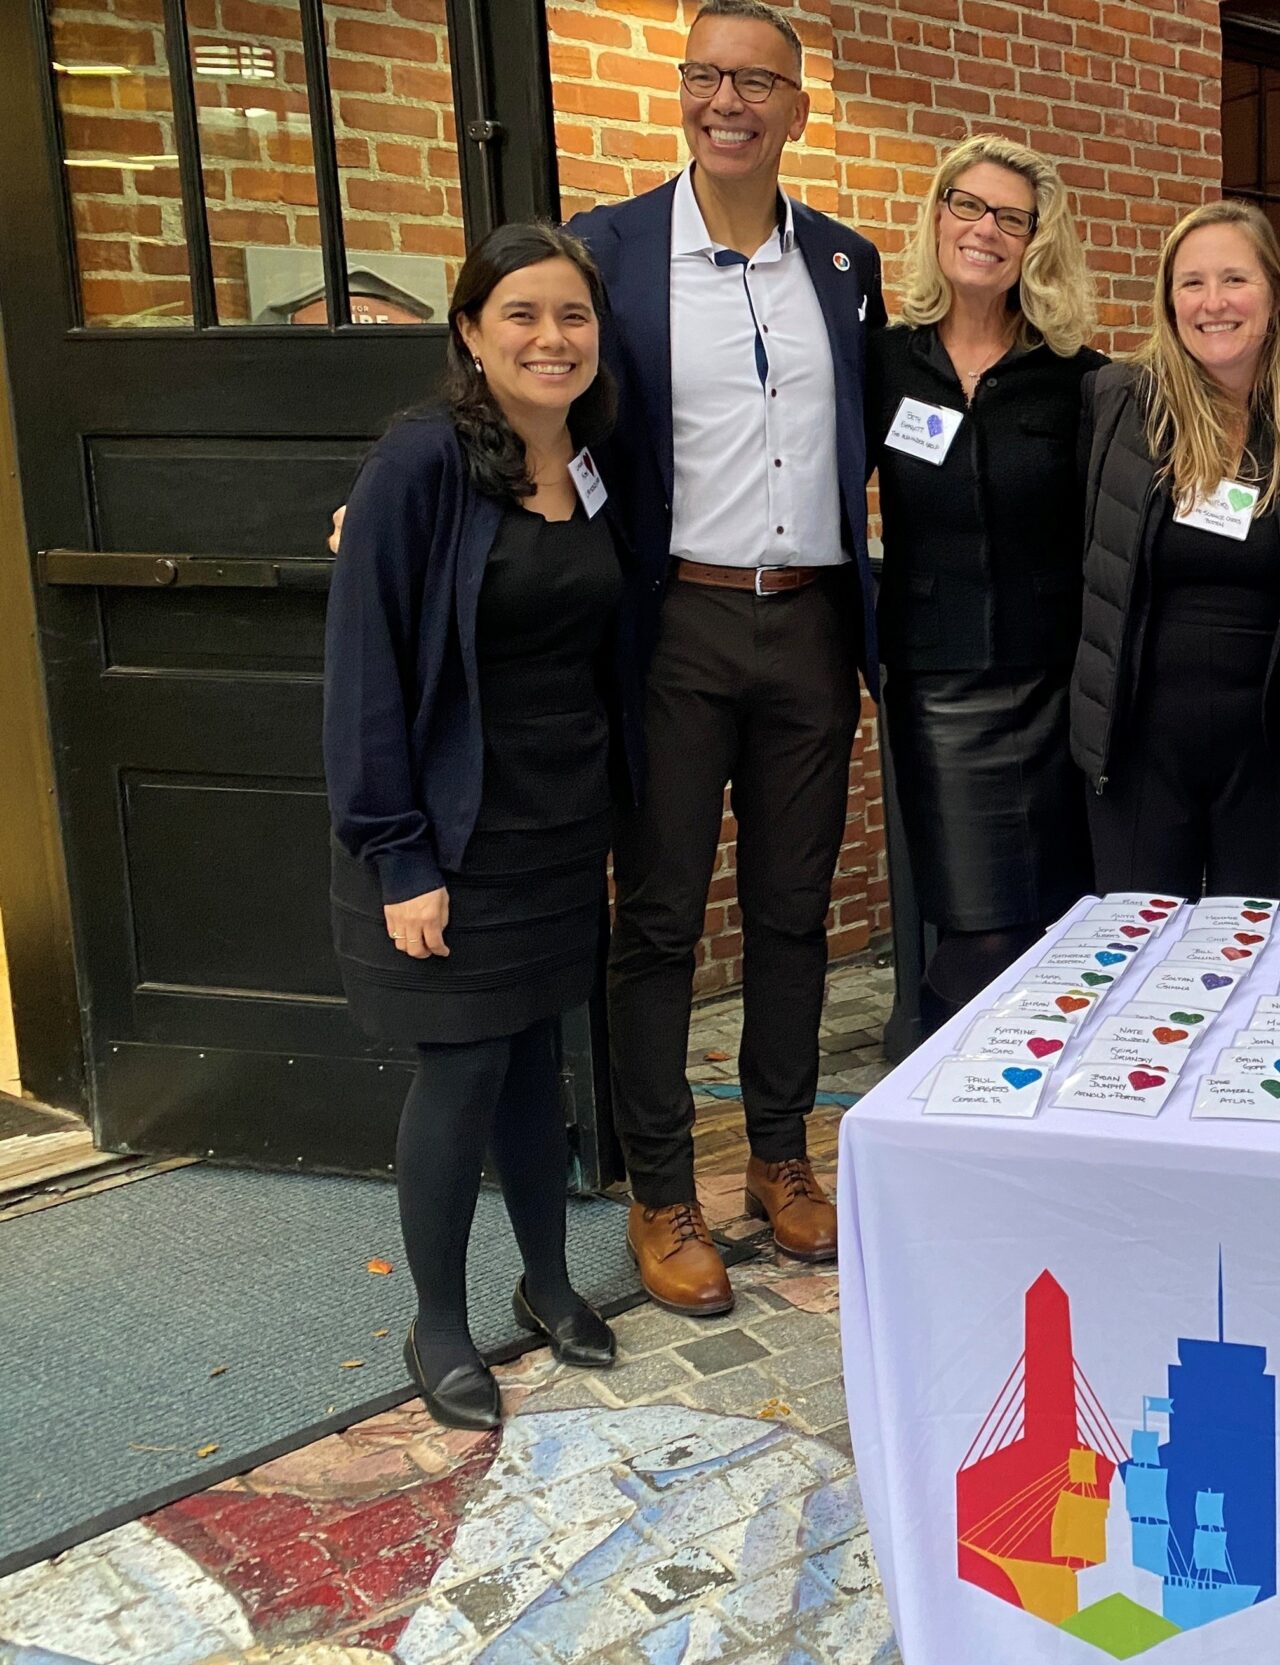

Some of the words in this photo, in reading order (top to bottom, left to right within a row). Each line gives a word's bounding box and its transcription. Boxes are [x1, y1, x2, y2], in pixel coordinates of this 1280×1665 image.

[1161, 974, 1194, 983] ZOLTAN
[994, 1026, 1038, 1036] KATRINE
[1119, 1027, 1144, 1035] NATE
[987, 1036, 1024, 1046] BOSLEY
[1250, 1037, 1275, 1045] JOHN
[964, 1075, 996, 1084] PAUL
[964, 1084, 1010, 1093] BURGESS
[1074, 1090, 1106, 1099] ARNOLD
[1219, 1097, 1255, 1105] ATLAS
